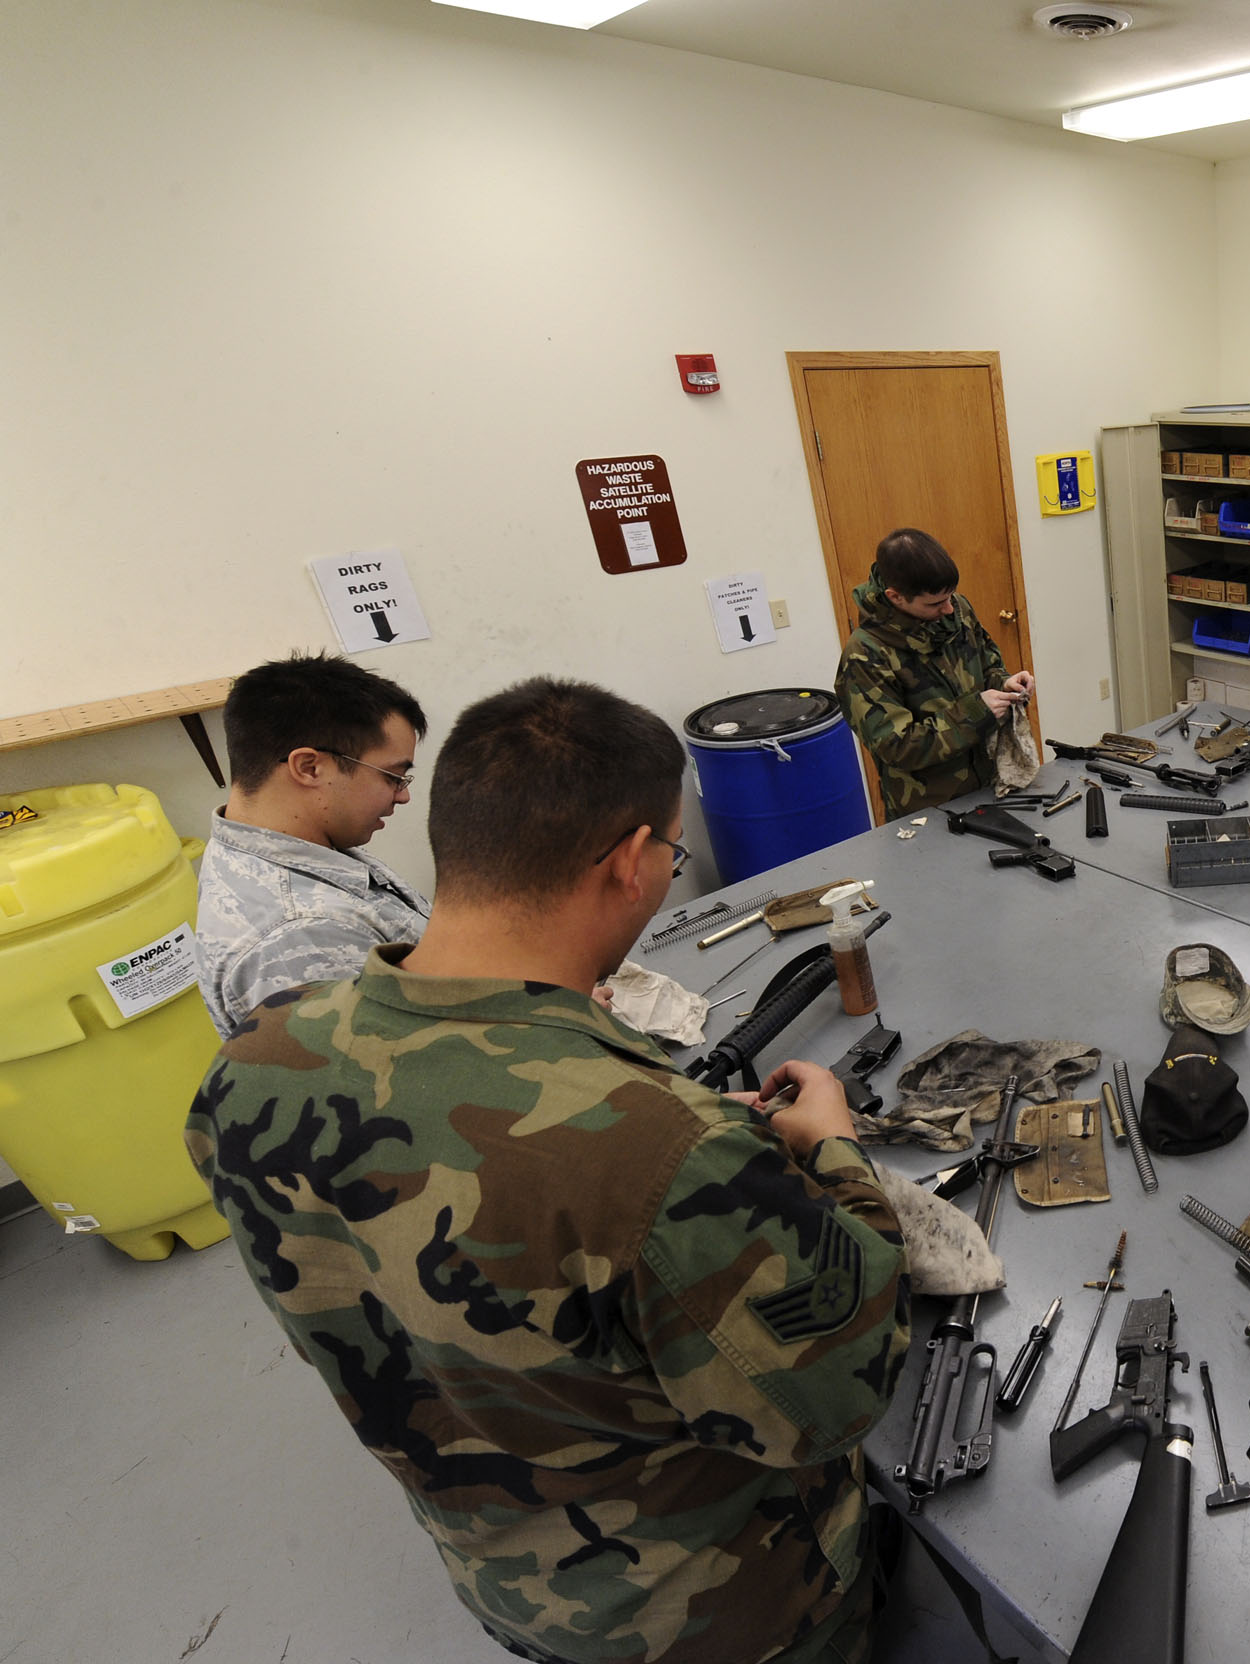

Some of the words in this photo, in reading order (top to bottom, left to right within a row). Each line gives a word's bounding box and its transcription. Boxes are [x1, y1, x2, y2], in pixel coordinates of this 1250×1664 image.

[587, 461, 655, 475] HAZARDOUS
[606, 473, 643, 485] WASTE
[600, 484, 654, 498] SATELLITE
[589, 493, 671, 511] ACCUMULATION
[617, 506, 648, 519] POINT
[338, 562, 382, 577] DIRTY
[347, 581, 388, 595] RAGS
[353, 599, 398, 614] ONLY!
[727, 596, 753, 604] CLEANERS
[129, 940, 172, 968] ENPAC
[109, 969, 144, 987] Wheeled
